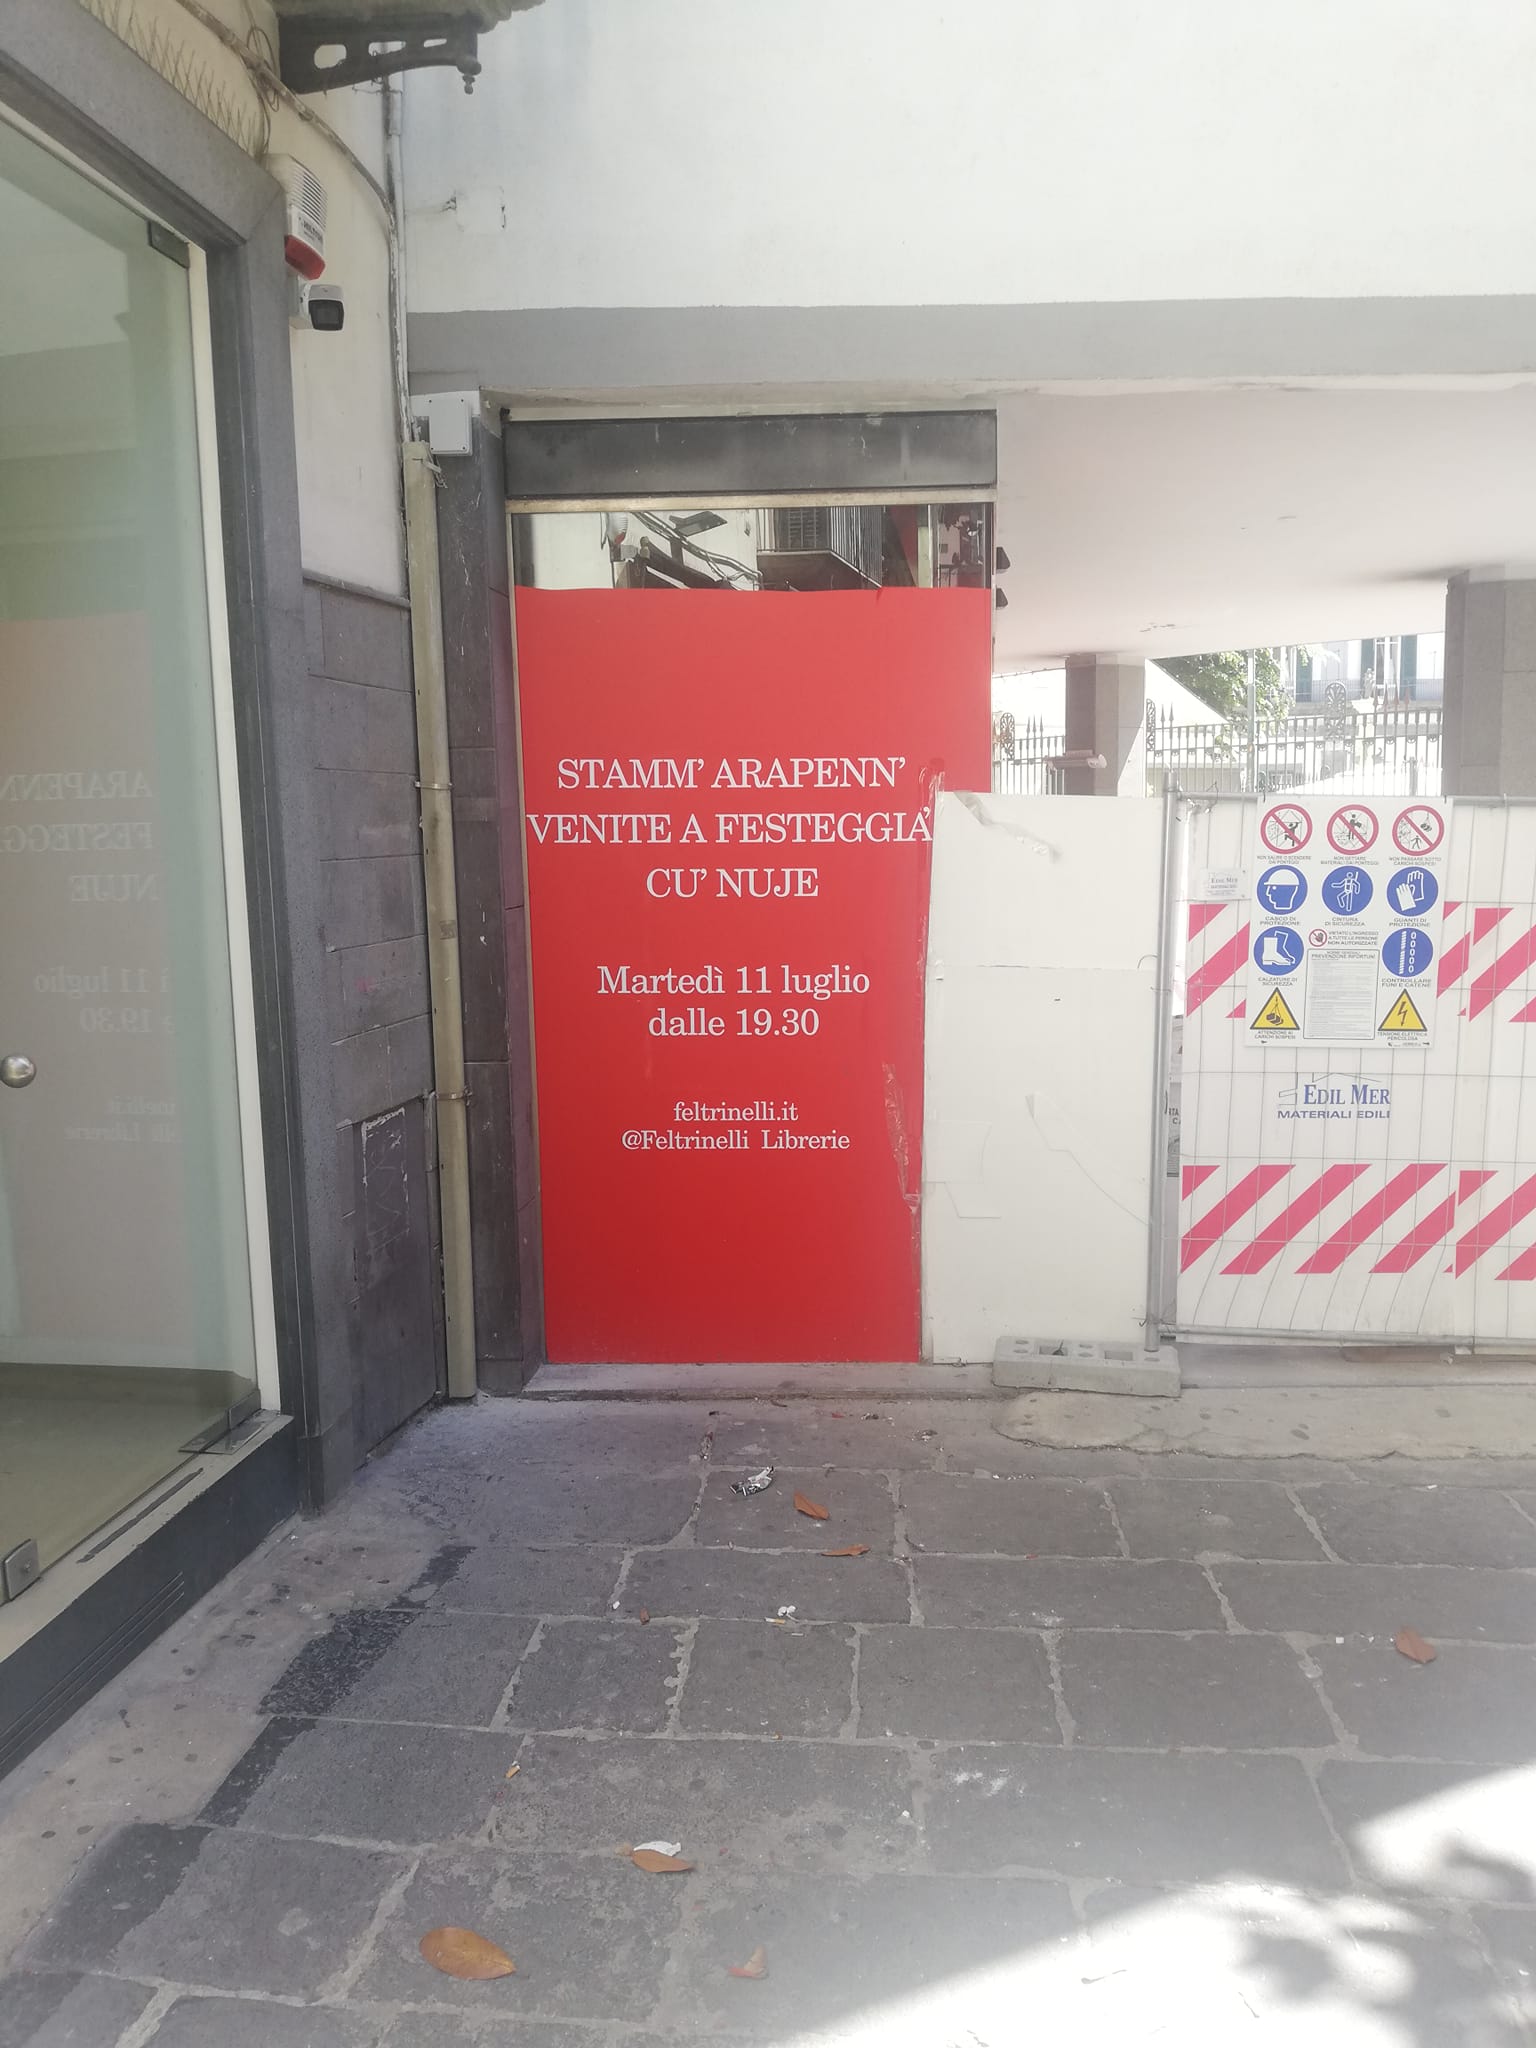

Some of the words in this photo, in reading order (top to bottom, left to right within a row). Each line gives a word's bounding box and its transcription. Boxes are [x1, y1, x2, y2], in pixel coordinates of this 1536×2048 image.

[558, 757, 704, 789] STAMM'
[711, 756, 906, 789] ARAPENN'
[527, 814, 671, 844] VENITE
[680, 813, 707, 843] A
[646, 868, 707, 898] CU'
[716, 867, 819, 898] NUJE
[597, 965, 726, 994] Martedì
[736, 966, 772, 994] 11
[780, 964, 870, 1001] luglio
[648, 1007, 725, 1037] dalle
[736, 1008, 820, 1037] 19.30
[673, 1100, 799, 1122] feltrinelli.it
[1277, 1110, 1352, 1119] MATERIALI
[1356, 1110, 1391, 1119] EDILI
[621, 1129, 750, 1151] @Feltrinelli
[761, 1129, 850, 1151] Librerie
